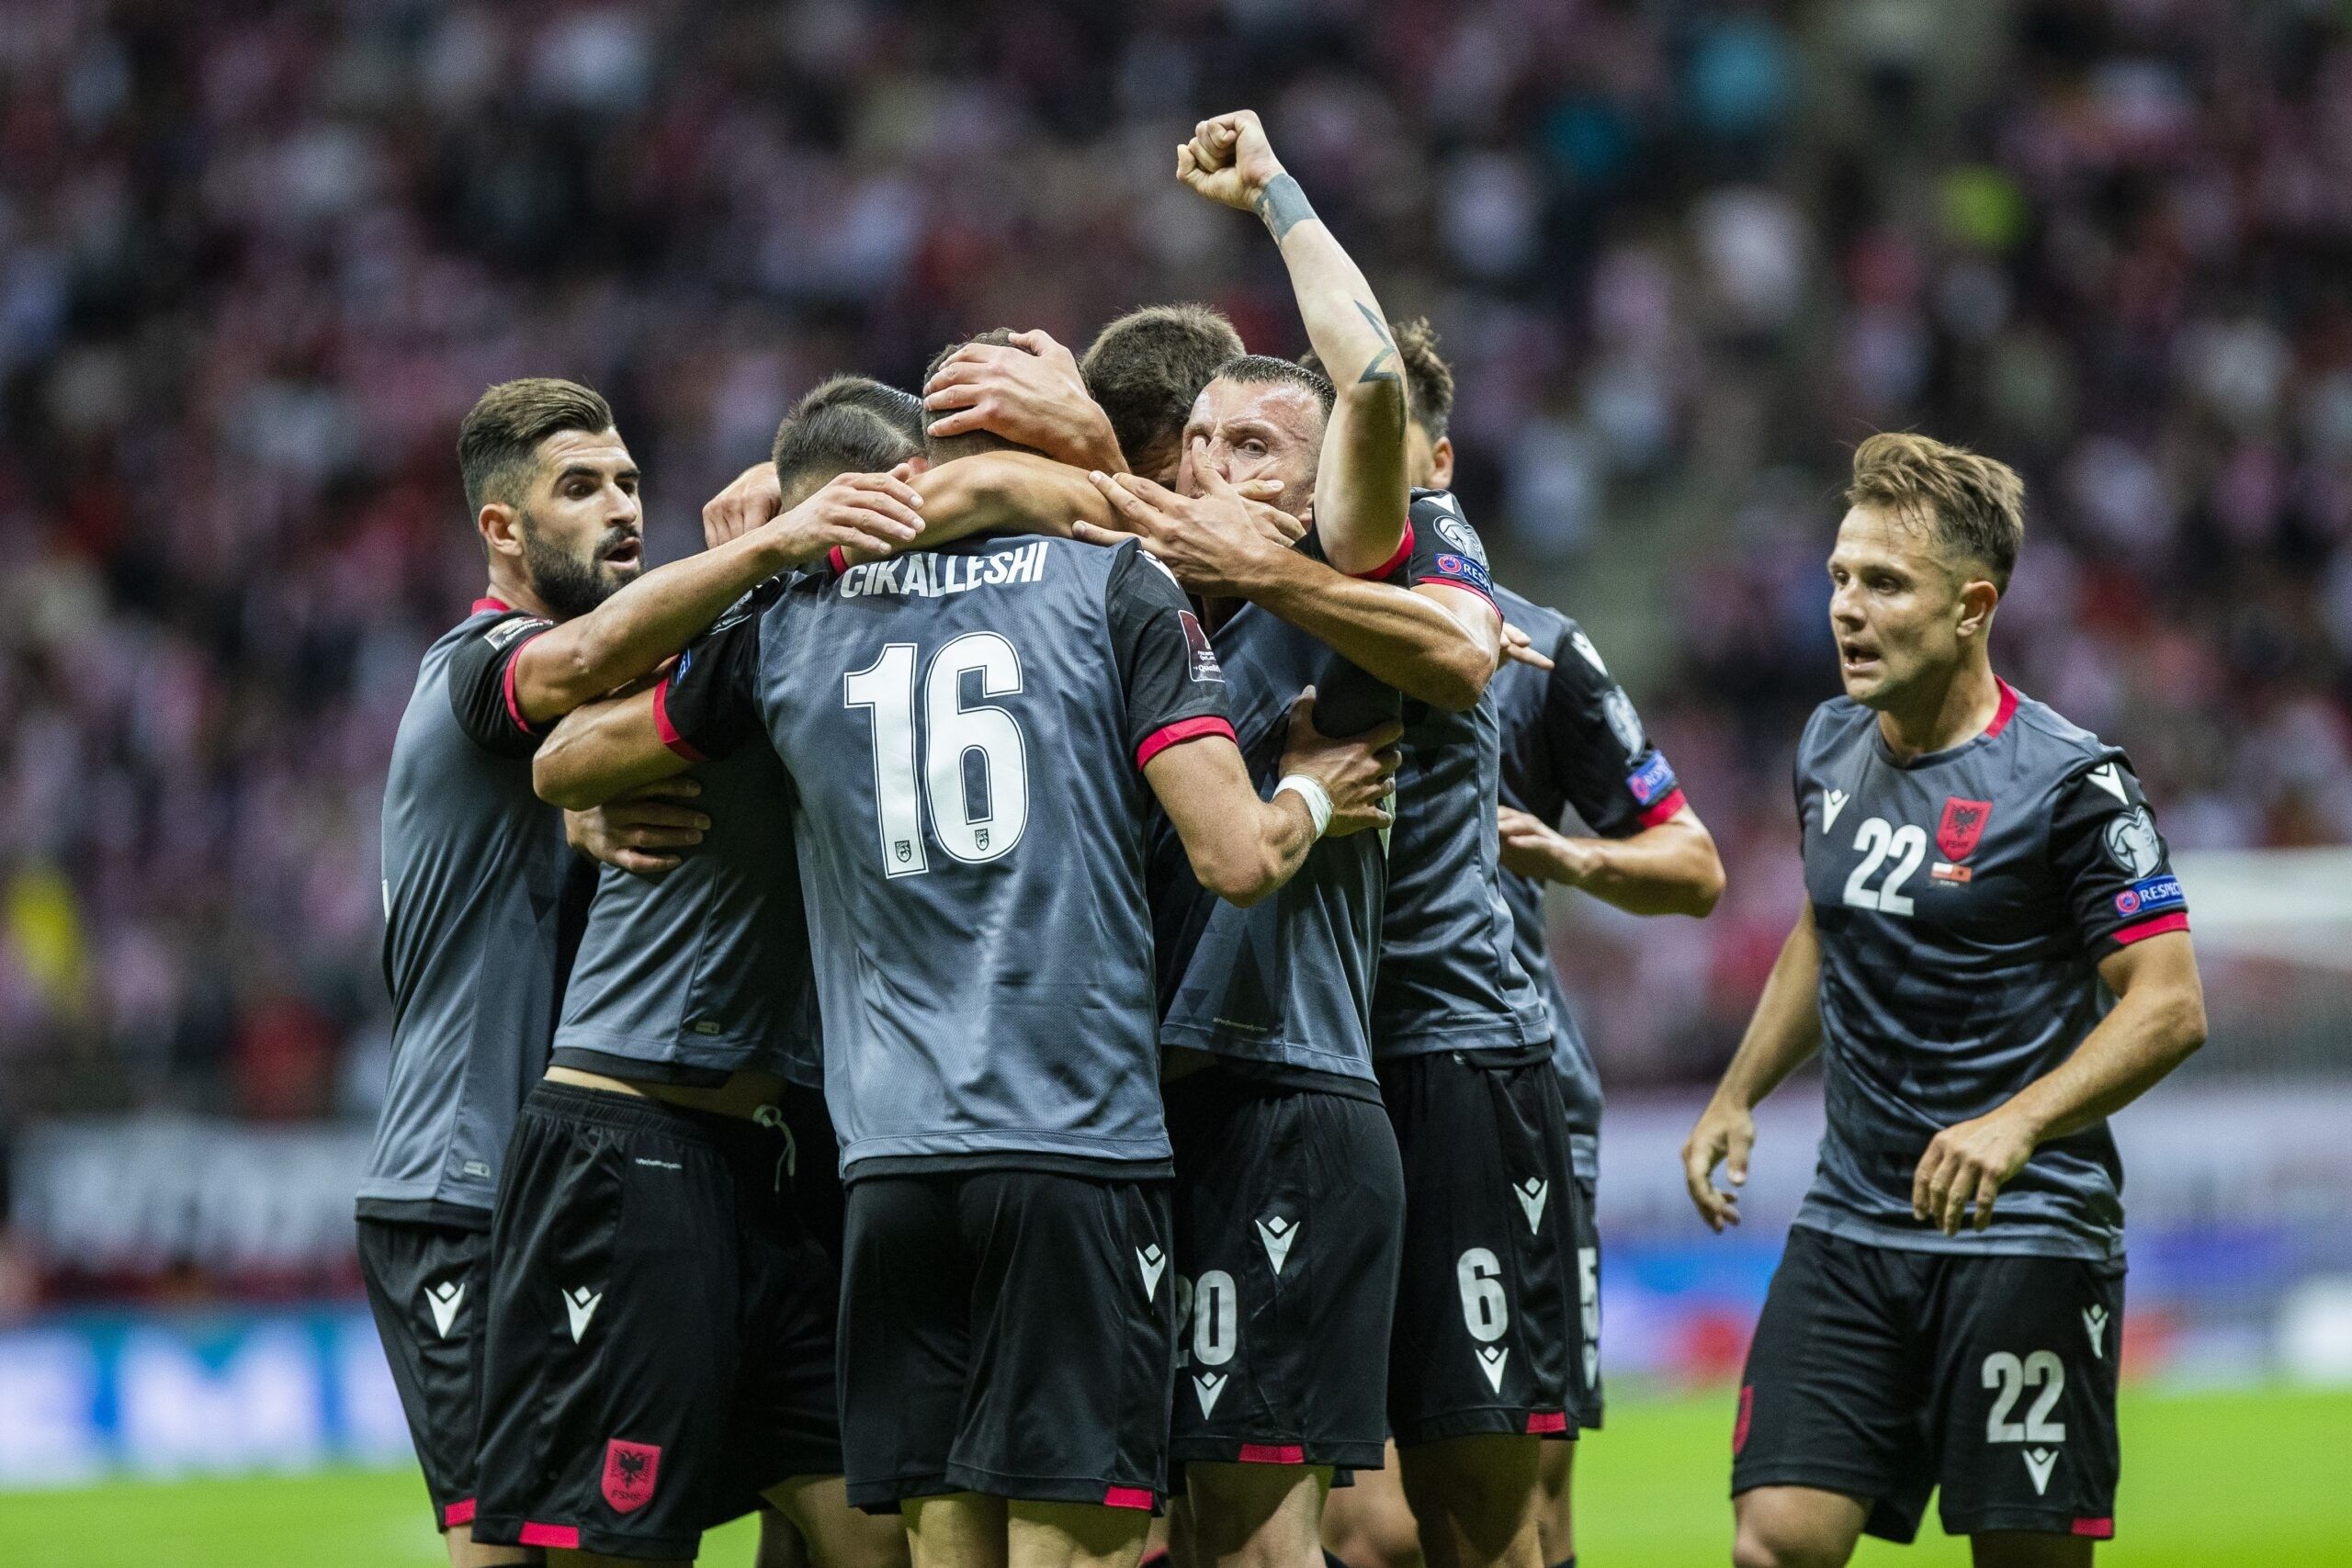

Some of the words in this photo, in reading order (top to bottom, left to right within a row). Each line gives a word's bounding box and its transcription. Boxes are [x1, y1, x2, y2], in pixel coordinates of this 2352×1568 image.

[839, 541, 1050, 599] CIKALLESHI
[843, 630, 1030, 880] 16
[1842, 817, 1928, 917] 22
[1456, 1247, 1509, 1342] 6
[1982, 1349, 2066, 1443] 22
